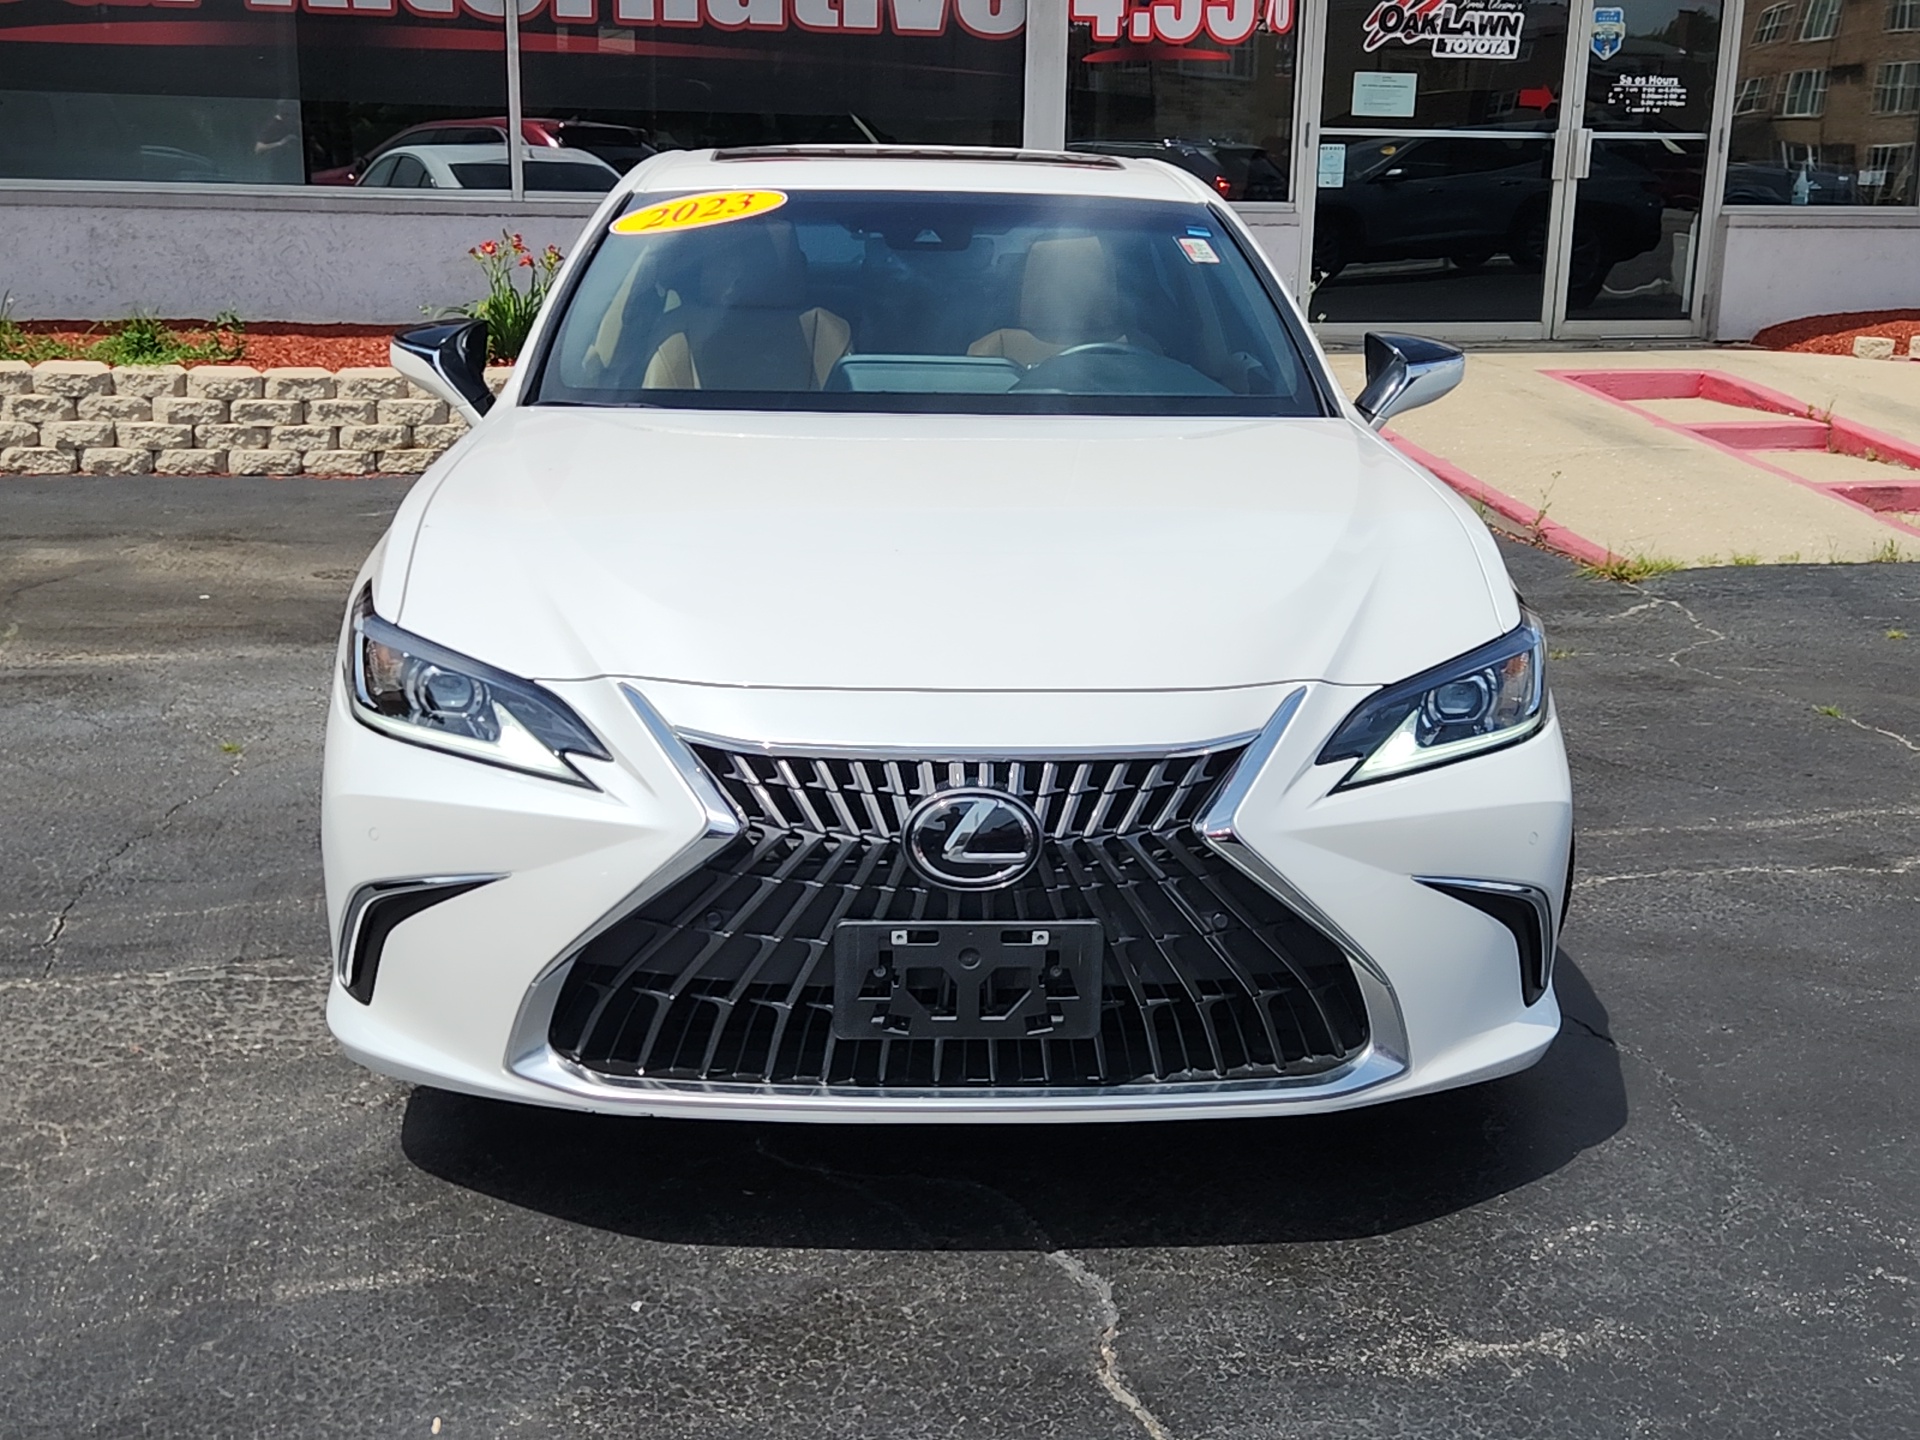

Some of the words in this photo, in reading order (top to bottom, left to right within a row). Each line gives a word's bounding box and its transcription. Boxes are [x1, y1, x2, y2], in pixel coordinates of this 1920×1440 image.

[1443, 38, 1511, 55] TOYOTA
[1619, 74, 1646, 86] Saes
[1648, 75, 1679, 86] Hours
[640, 193, 756, 230] 2023
